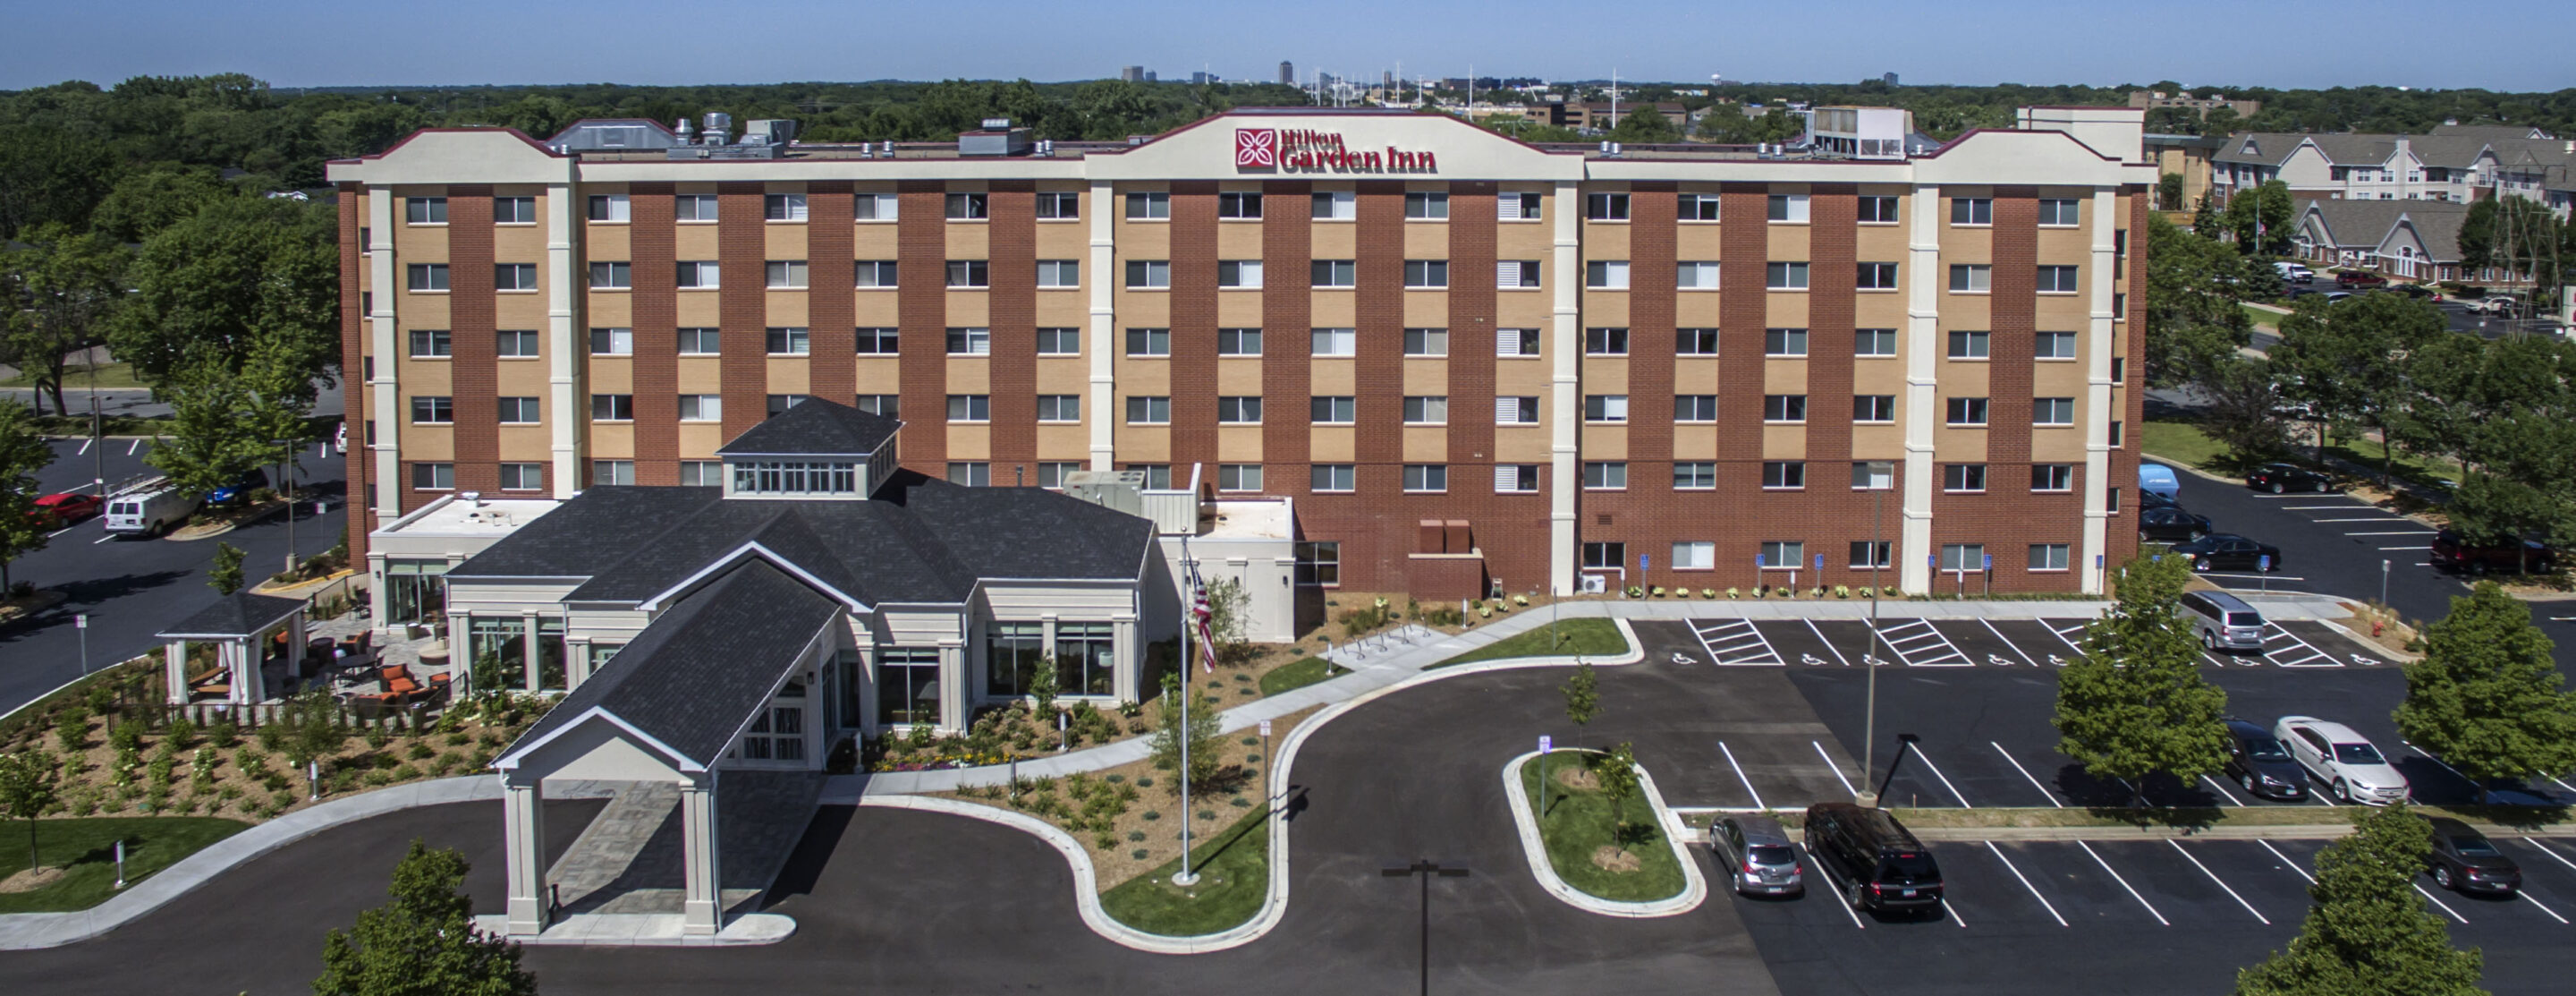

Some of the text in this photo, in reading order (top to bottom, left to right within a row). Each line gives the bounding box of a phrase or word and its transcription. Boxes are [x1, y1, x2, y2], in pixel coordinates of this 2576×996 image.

[1280, 129, 1343, 146] Hilton
[1279, 145, 1436, 168] Garden Inn
